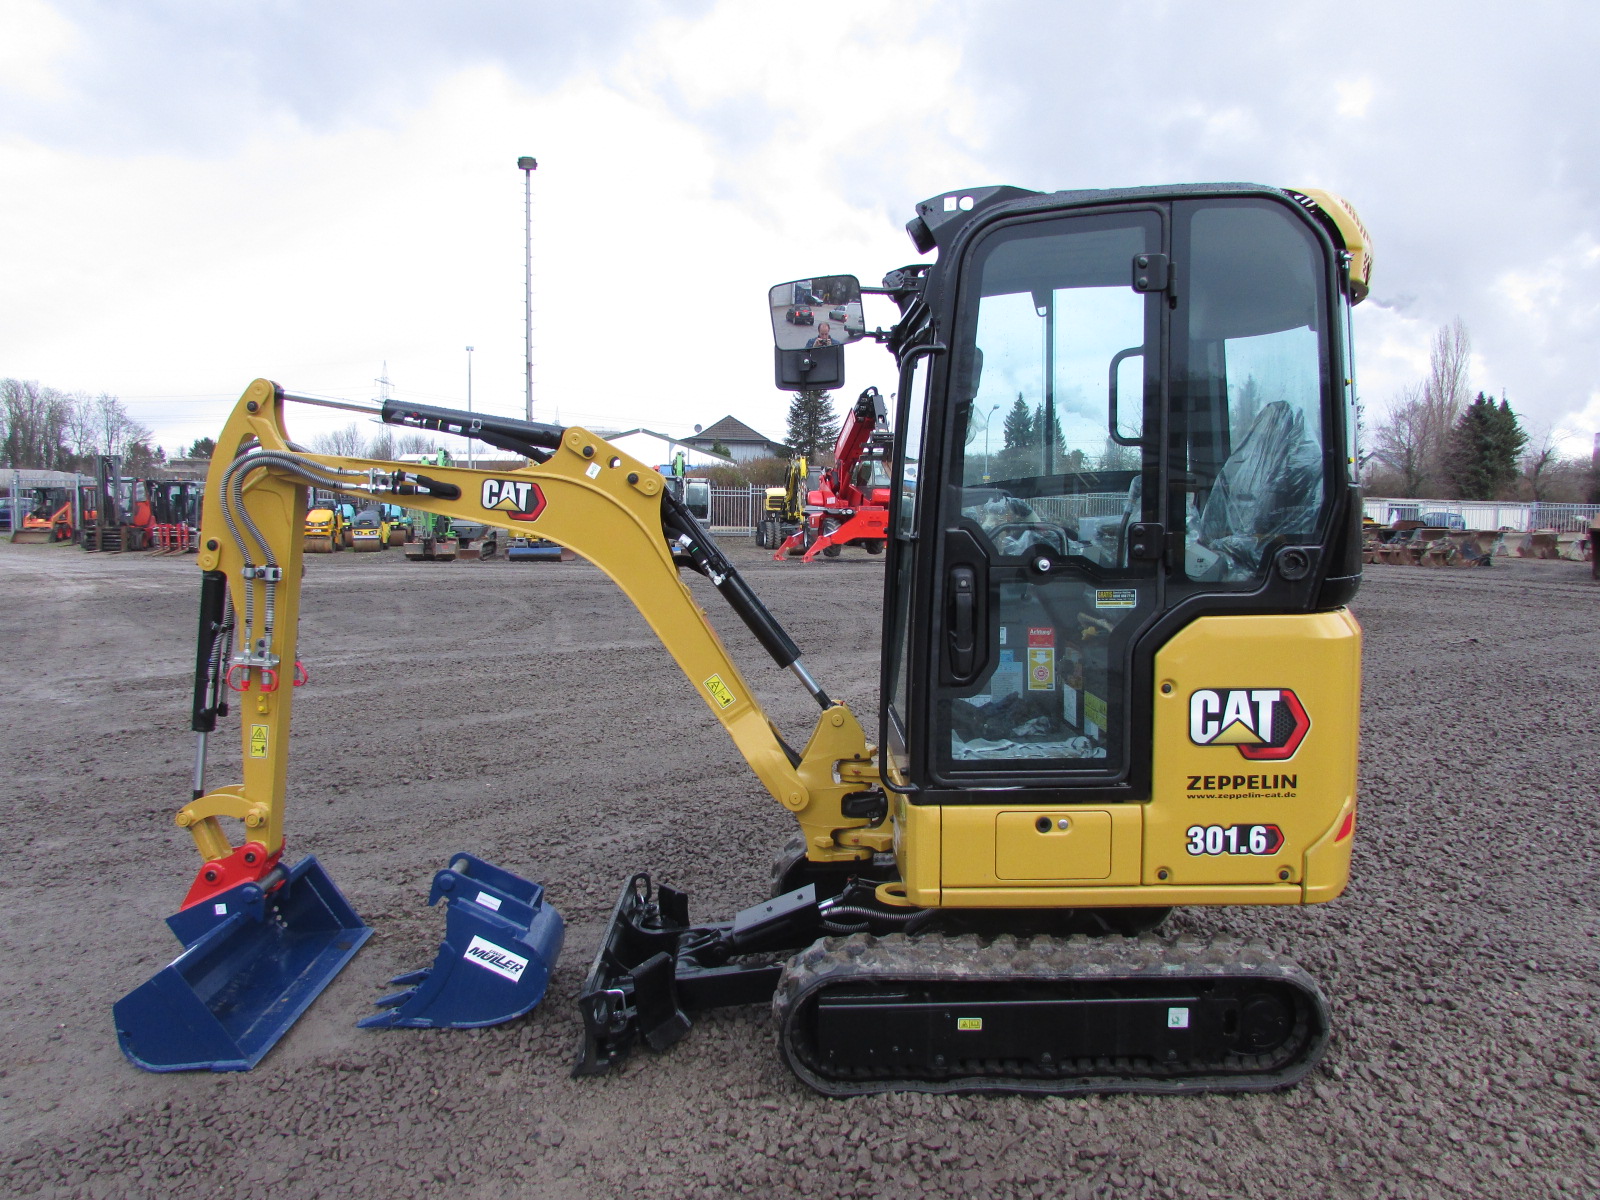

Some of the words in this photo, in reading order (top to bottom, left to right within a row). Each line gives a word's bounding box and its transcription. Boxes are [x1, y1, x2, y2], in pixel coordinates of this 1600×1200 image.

[482, 479, 532, 512] CAT
[1190, 689, 1280, 744] CAT
[1186, 774, 1297, 790] ZEPPELIN
[1186, 825, 1267, 854] 301.6
